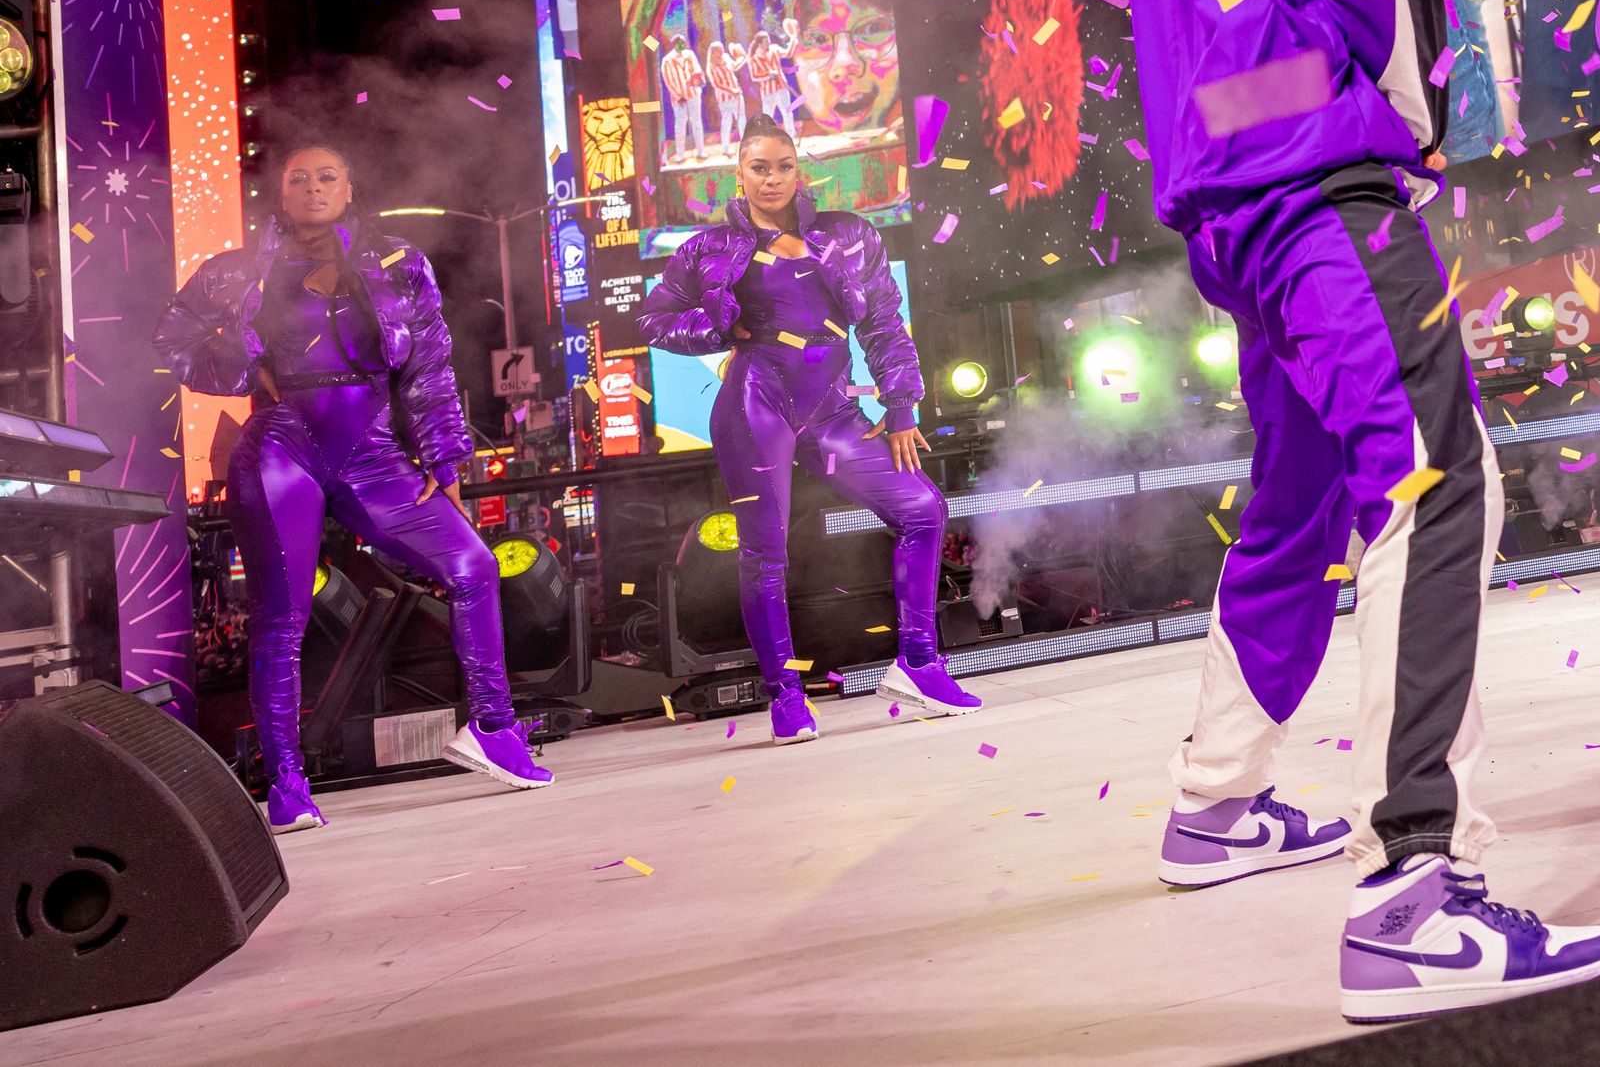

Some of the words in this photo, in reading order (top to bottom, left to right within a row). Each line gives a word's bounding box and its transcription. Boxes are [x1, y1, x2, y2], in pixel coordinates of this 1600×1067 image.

[600, 203, 632, 221] SHOW
[594, 229, 640, 248] LIFETIME
[600, 275, 643, 289] ACHETER
[500, 380, 529, 392] ONLY
